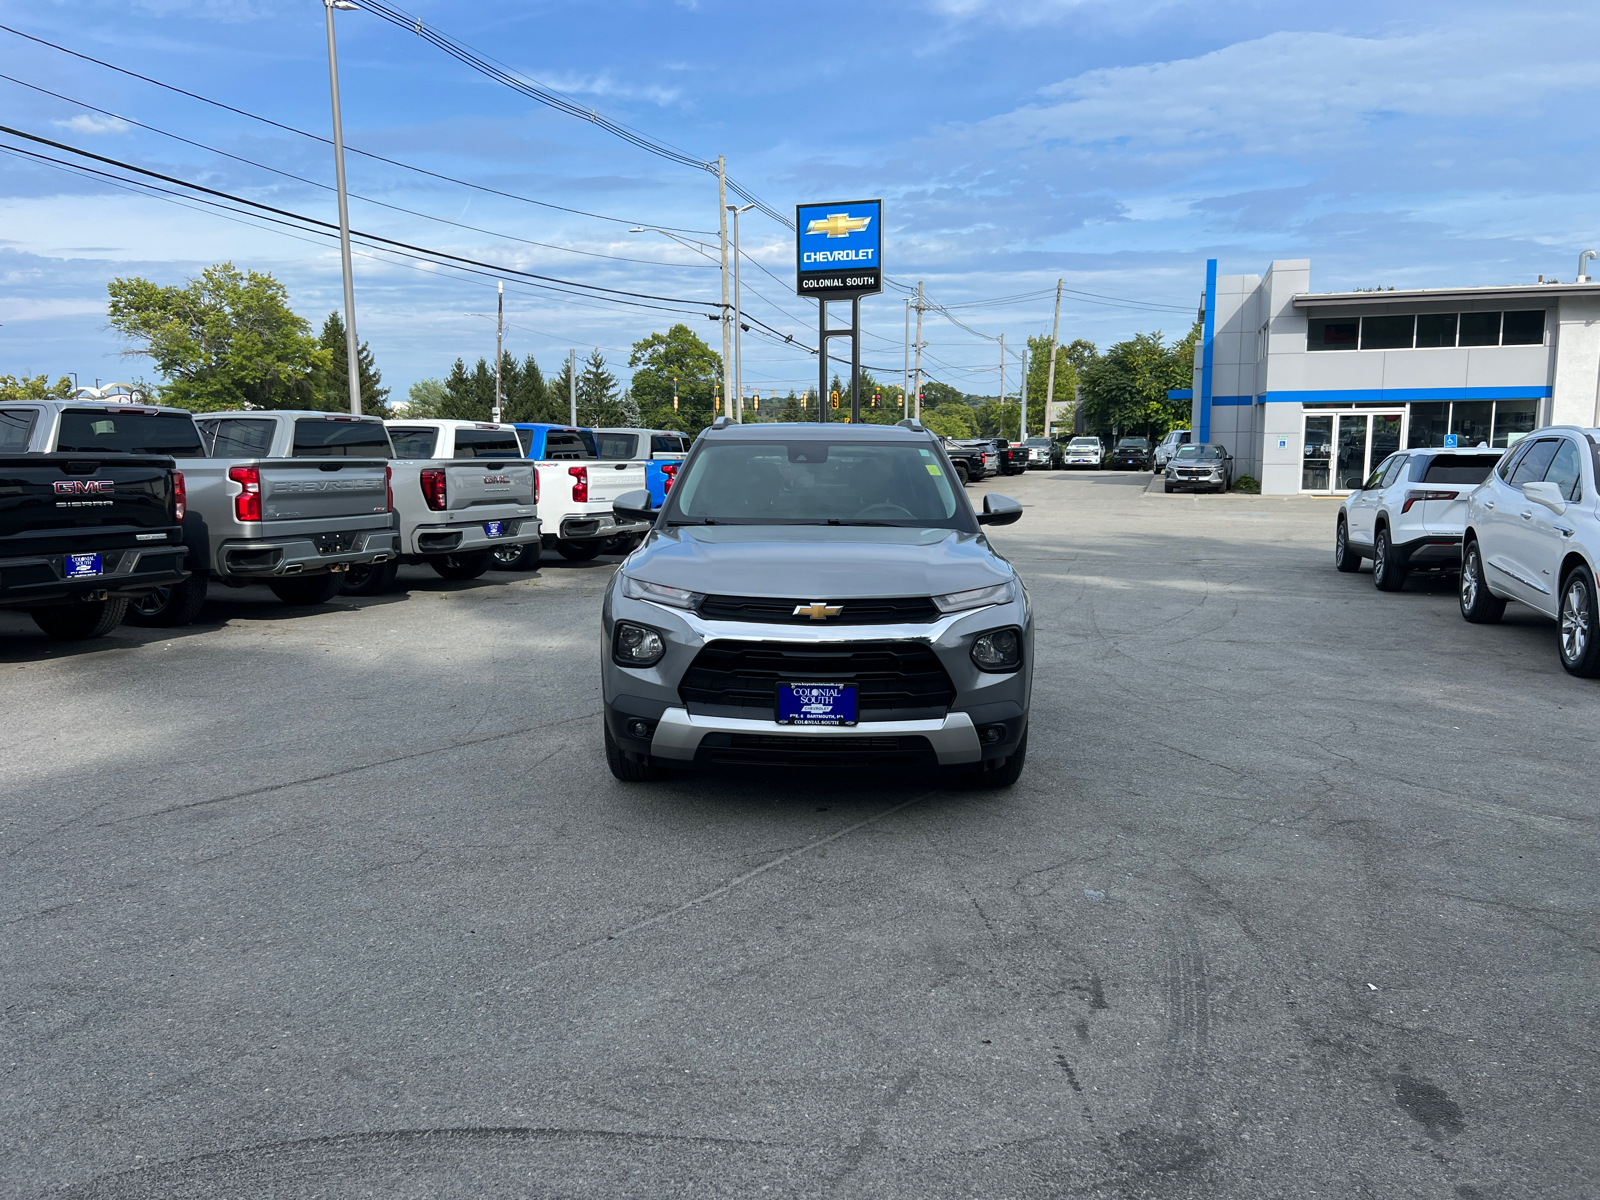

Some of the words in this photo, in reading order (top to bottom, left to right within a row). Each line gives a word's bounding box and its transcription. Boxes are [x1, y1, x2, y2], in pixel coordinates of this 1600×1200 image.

[803, 248, 875, 263] CHEVROLET
[802, 278, 844, 288] COLONIAL
[846, 276, 875, 286] SOUTH
[483, 475, 510, 484] GMC
[594, 475, 644, 484] CHEVROLET
[52, 480, 115, 494] GMC
[273, 479, 383, 493] CHEVROLET
[55, 500, 114, 508] SIERRA
[793, 688, 841, 697] COLONIAL
[800, 696, 833, 704] SOUTH
